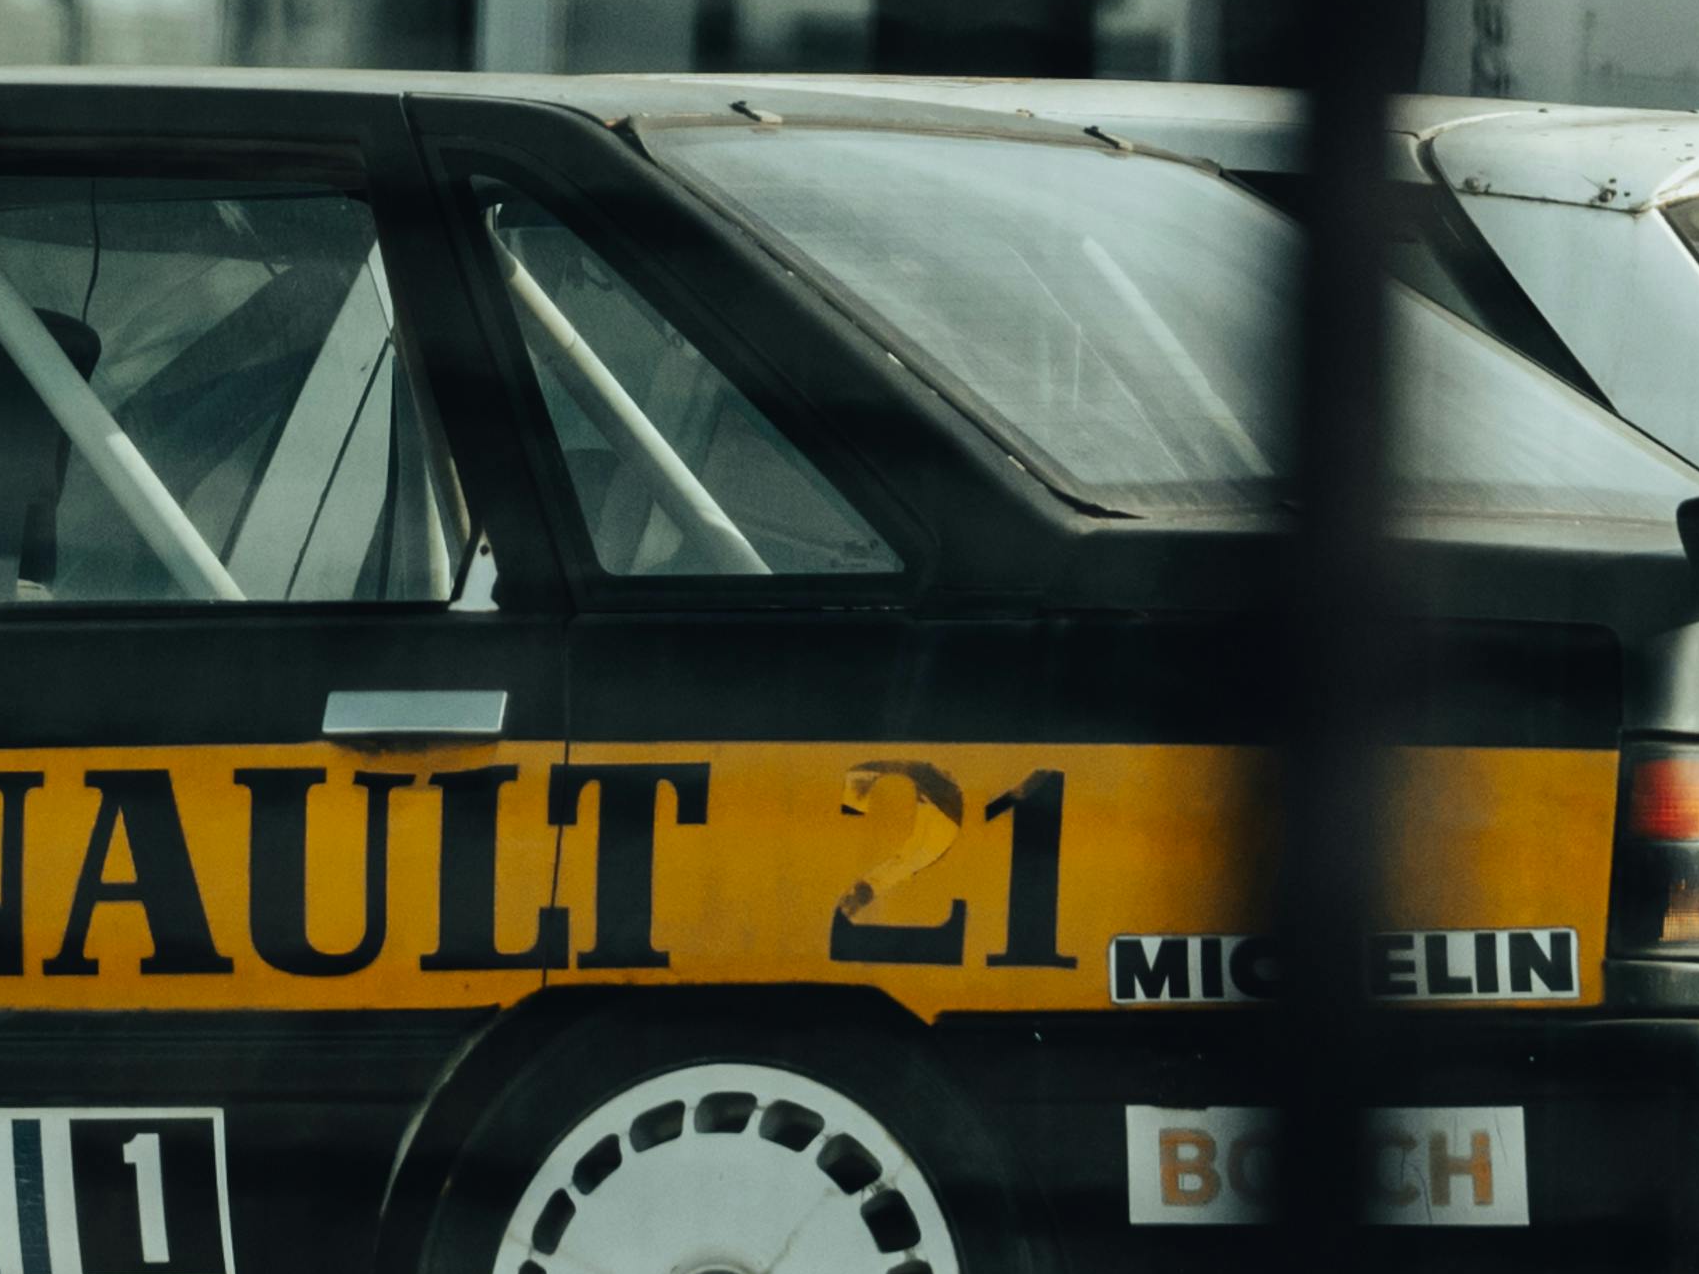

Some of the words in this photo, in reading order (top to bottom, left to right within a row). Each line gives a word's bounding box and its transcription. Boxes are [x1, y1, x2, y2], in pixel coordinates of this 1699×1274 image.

[830, 760, 1078, 970] 21
[1115, 931, 1574, 1001] MICELIN
[122, 1132, 171, 1265] 1
[1158, 1127, 1494, 1207] BOCH
